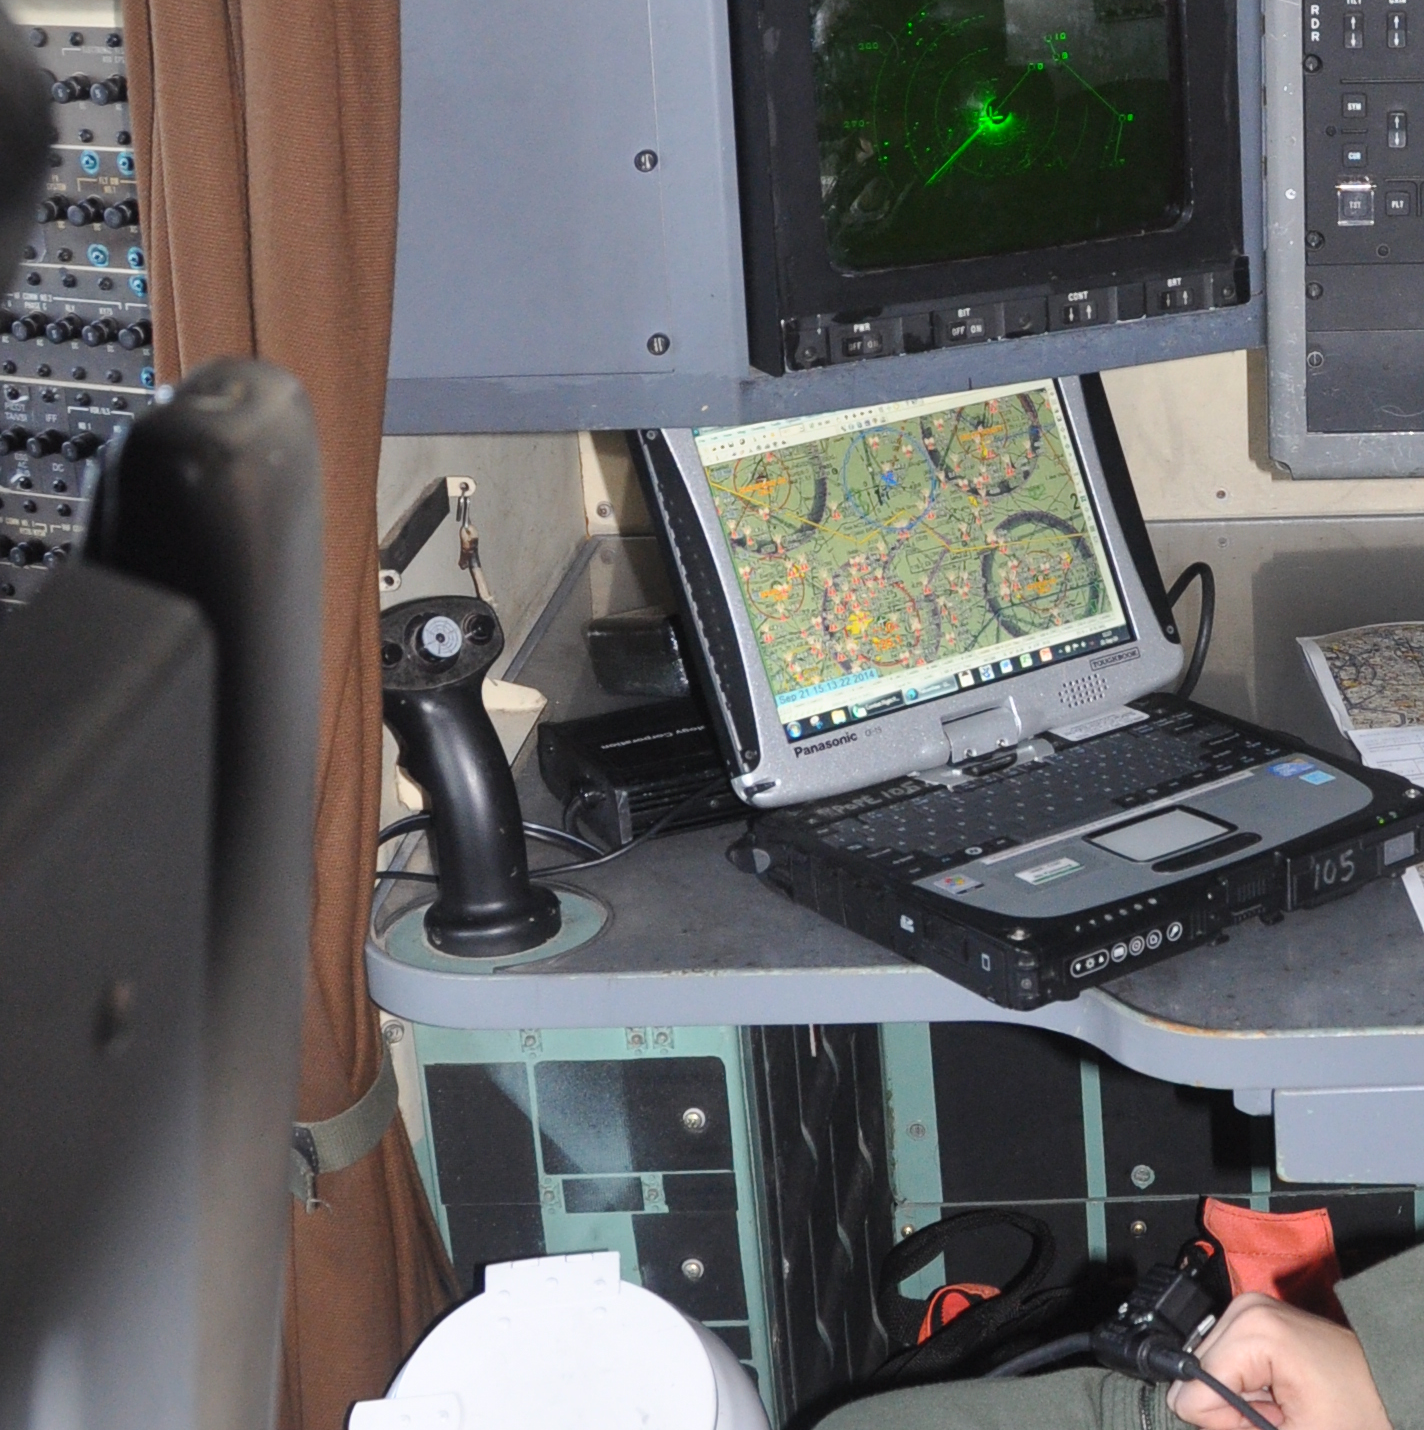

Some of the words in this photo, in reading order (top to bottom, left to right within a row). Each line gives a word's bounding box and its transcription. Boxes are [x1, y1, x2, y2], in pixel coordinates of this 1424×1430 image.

[1068, 291, 1089, 302] CONT
[779, 693, 797, 705] Sep
[800, 689, 810, 699] 21
[853, 670, 875, 683] 2014
[793, 730, 858, 759] Panasonic
[1313, 849, 1355, 890] 105
